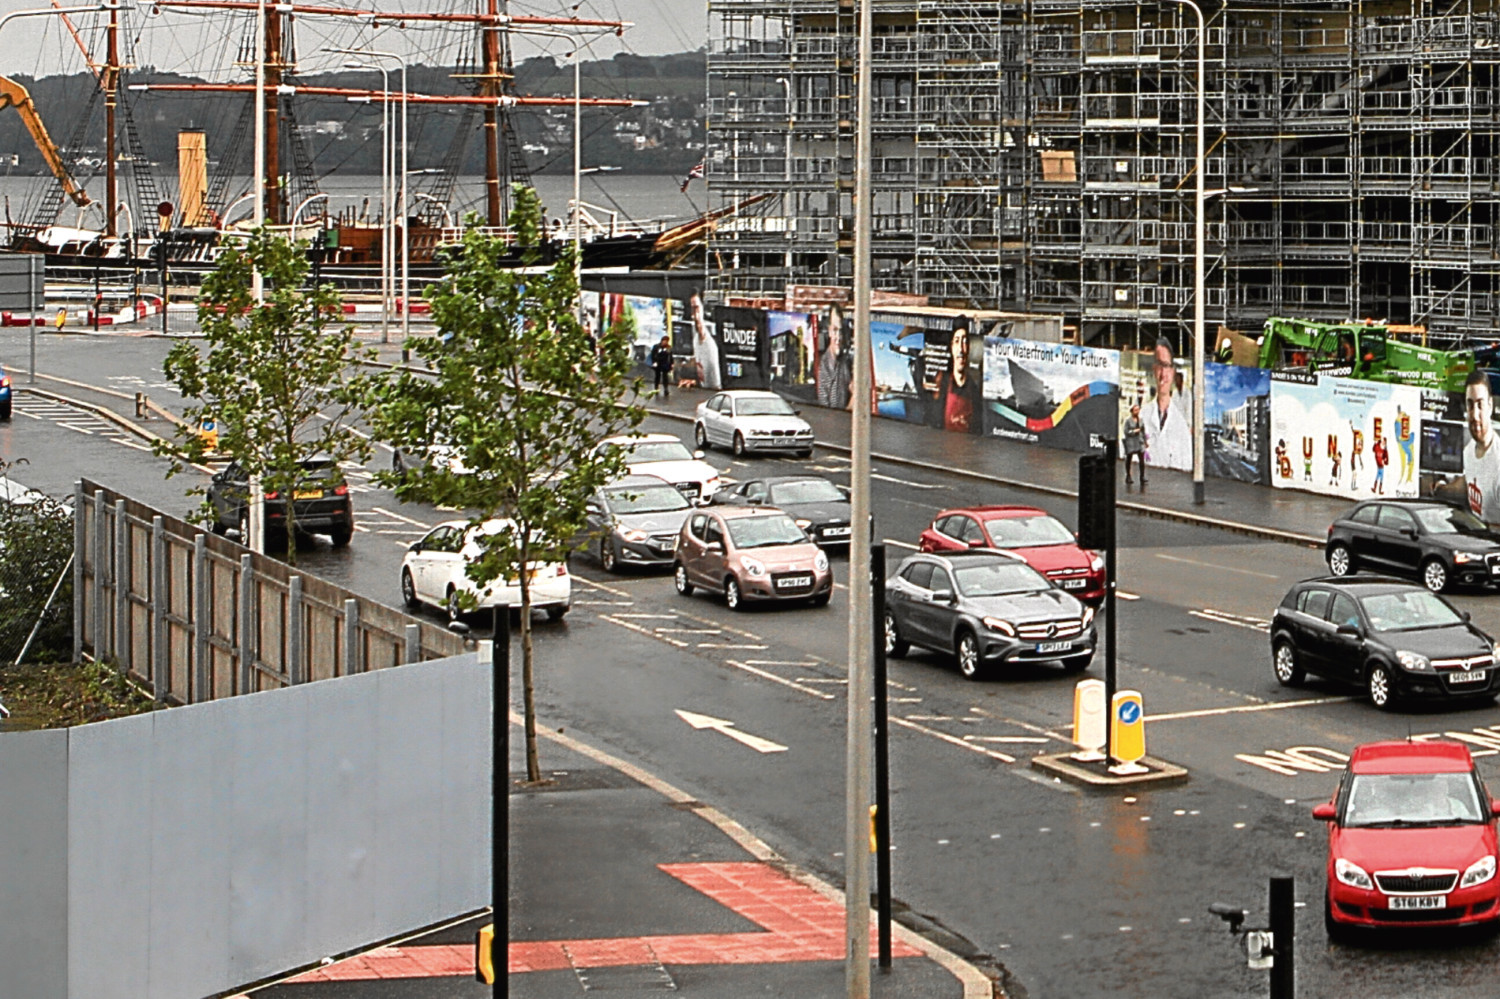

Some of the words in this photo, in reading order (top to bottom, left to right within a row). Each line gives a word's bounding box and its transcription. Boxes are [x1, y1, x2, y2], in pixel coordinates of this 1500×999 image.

[723, 328, 757, 345] DUNDEE
[993, 342, 1010, 356] Your
[1012, 344, 1054, 362] Waterfront
[1060, 348, 1079, 365] Your
[1080, 350, 1108, 368] Future
[1234, 746, 1350, 775] NO
